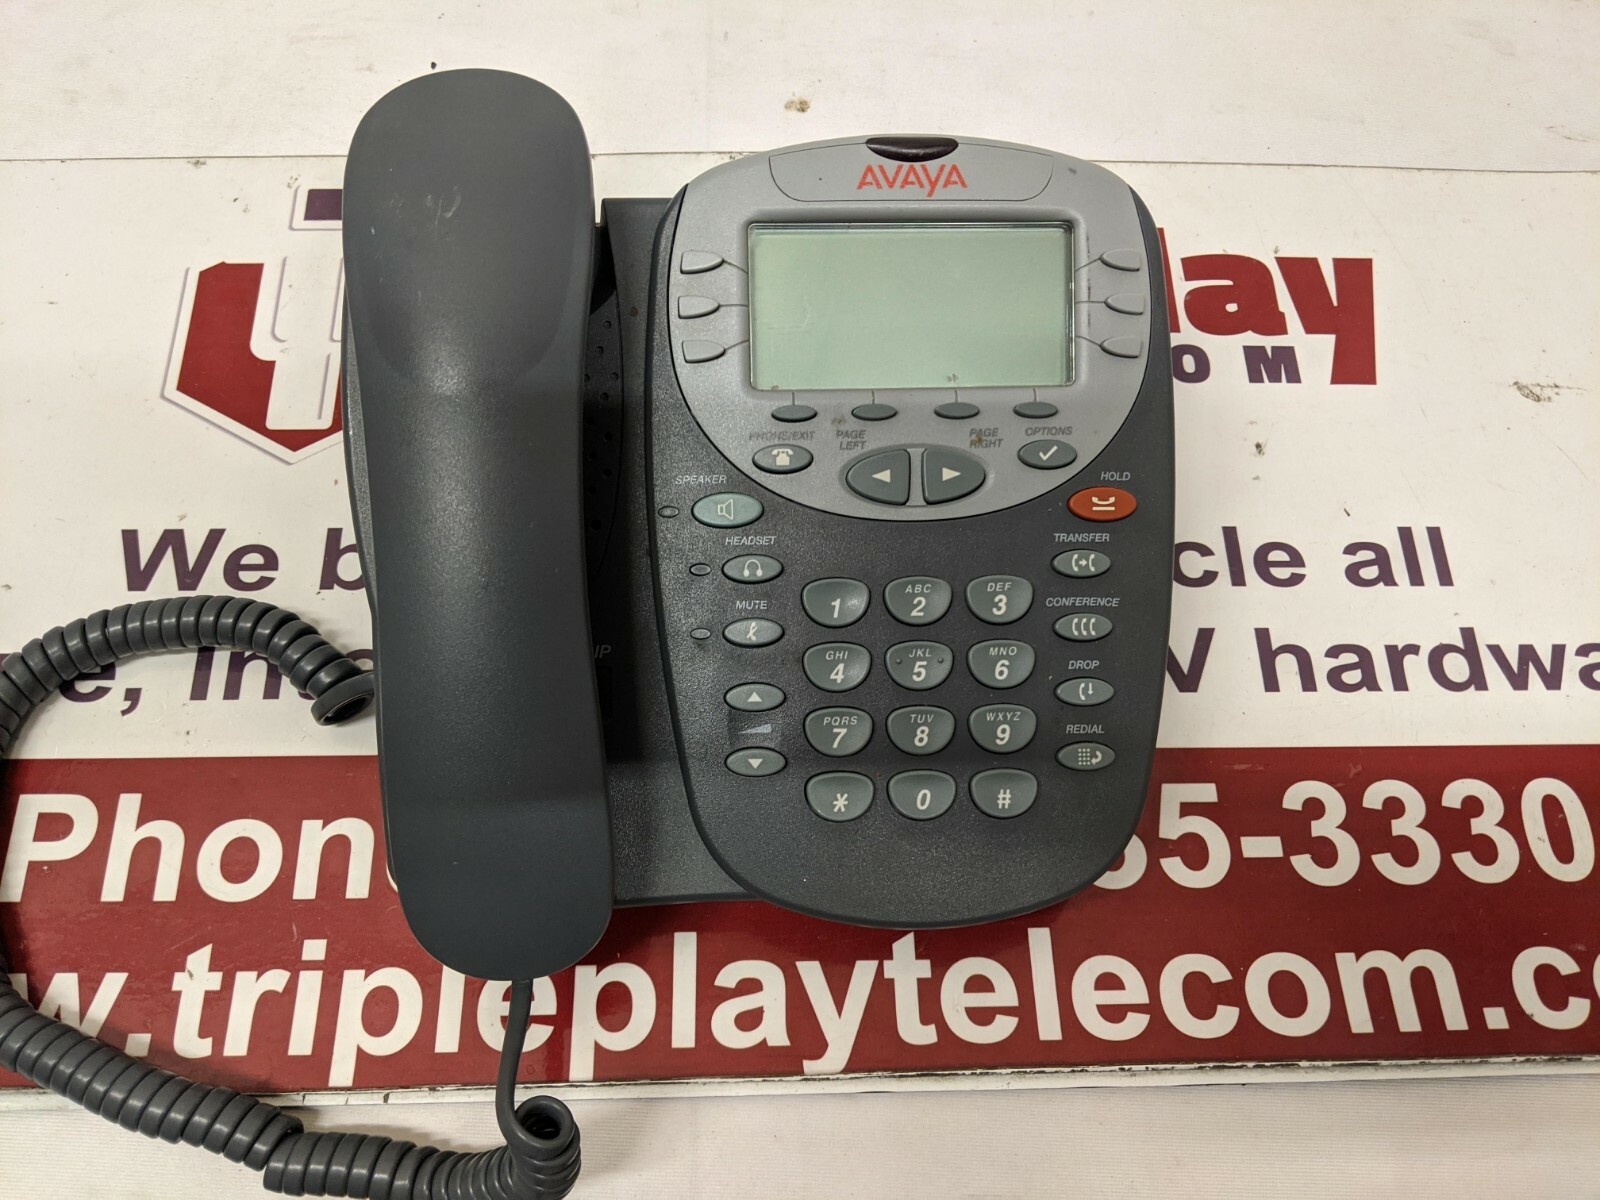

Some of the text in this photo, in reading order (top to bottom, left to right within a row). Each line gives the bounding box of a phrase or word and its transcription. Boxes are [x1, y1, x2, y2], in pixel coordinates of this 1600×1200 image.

[856, 164, 968, 197] AVAYA
[836, 429, 867, 440] PAGE
[969, 427, 999, 437] PAGE
[1025, 426, 1073, 437] OPTIONS
[839, 440, 867, 451] LEFT
[970, 438, 1004, 449] RIGHT
[675, 474, 728, 485] SPEAKER
[1100, 471, 1131, 481] HOLD
[725, 535, 777, 546] HEADSET
[1054, 532, 1110, 543] TRANSFER
[121, 527, 280, 592] We
[1342, 525, 1455, 588] all
[905, 583, 932, 594] ABC
[987, 582, 1012, 592] DEF
[735, 600, 768, 610] MUTE
[910, 596, 927, 617] 2
[992, 594, 1008, 616] 3
[1046, 596, 1120, 608] CONFERENCE
[831, 598, 841, 619] 1
[825, 650, 849, 660] GHI
[908, 648, 932, 658] JKL
[989, 646, 1018, 656] MNO
[994, 659, 1010, 680] 6
[1068, 660, 1100, 670] DROP
[830, 663, 845, 684] 4
[912, 661, 927, 682] 5
[823, 715, 858, 726] PQRS
[909, 714, 934, 724] TUV
[986, 711, 1022, 721] WXYZ
[995, 724, 1011, 745] 9
[1065, 724, 1105, 734] REDIAL
[832, 728, 847, 749] 7
[914, 726, 930, 747] 8
[916, 789, 932, 810] 0
[0, 792, 397, 903] Phon
